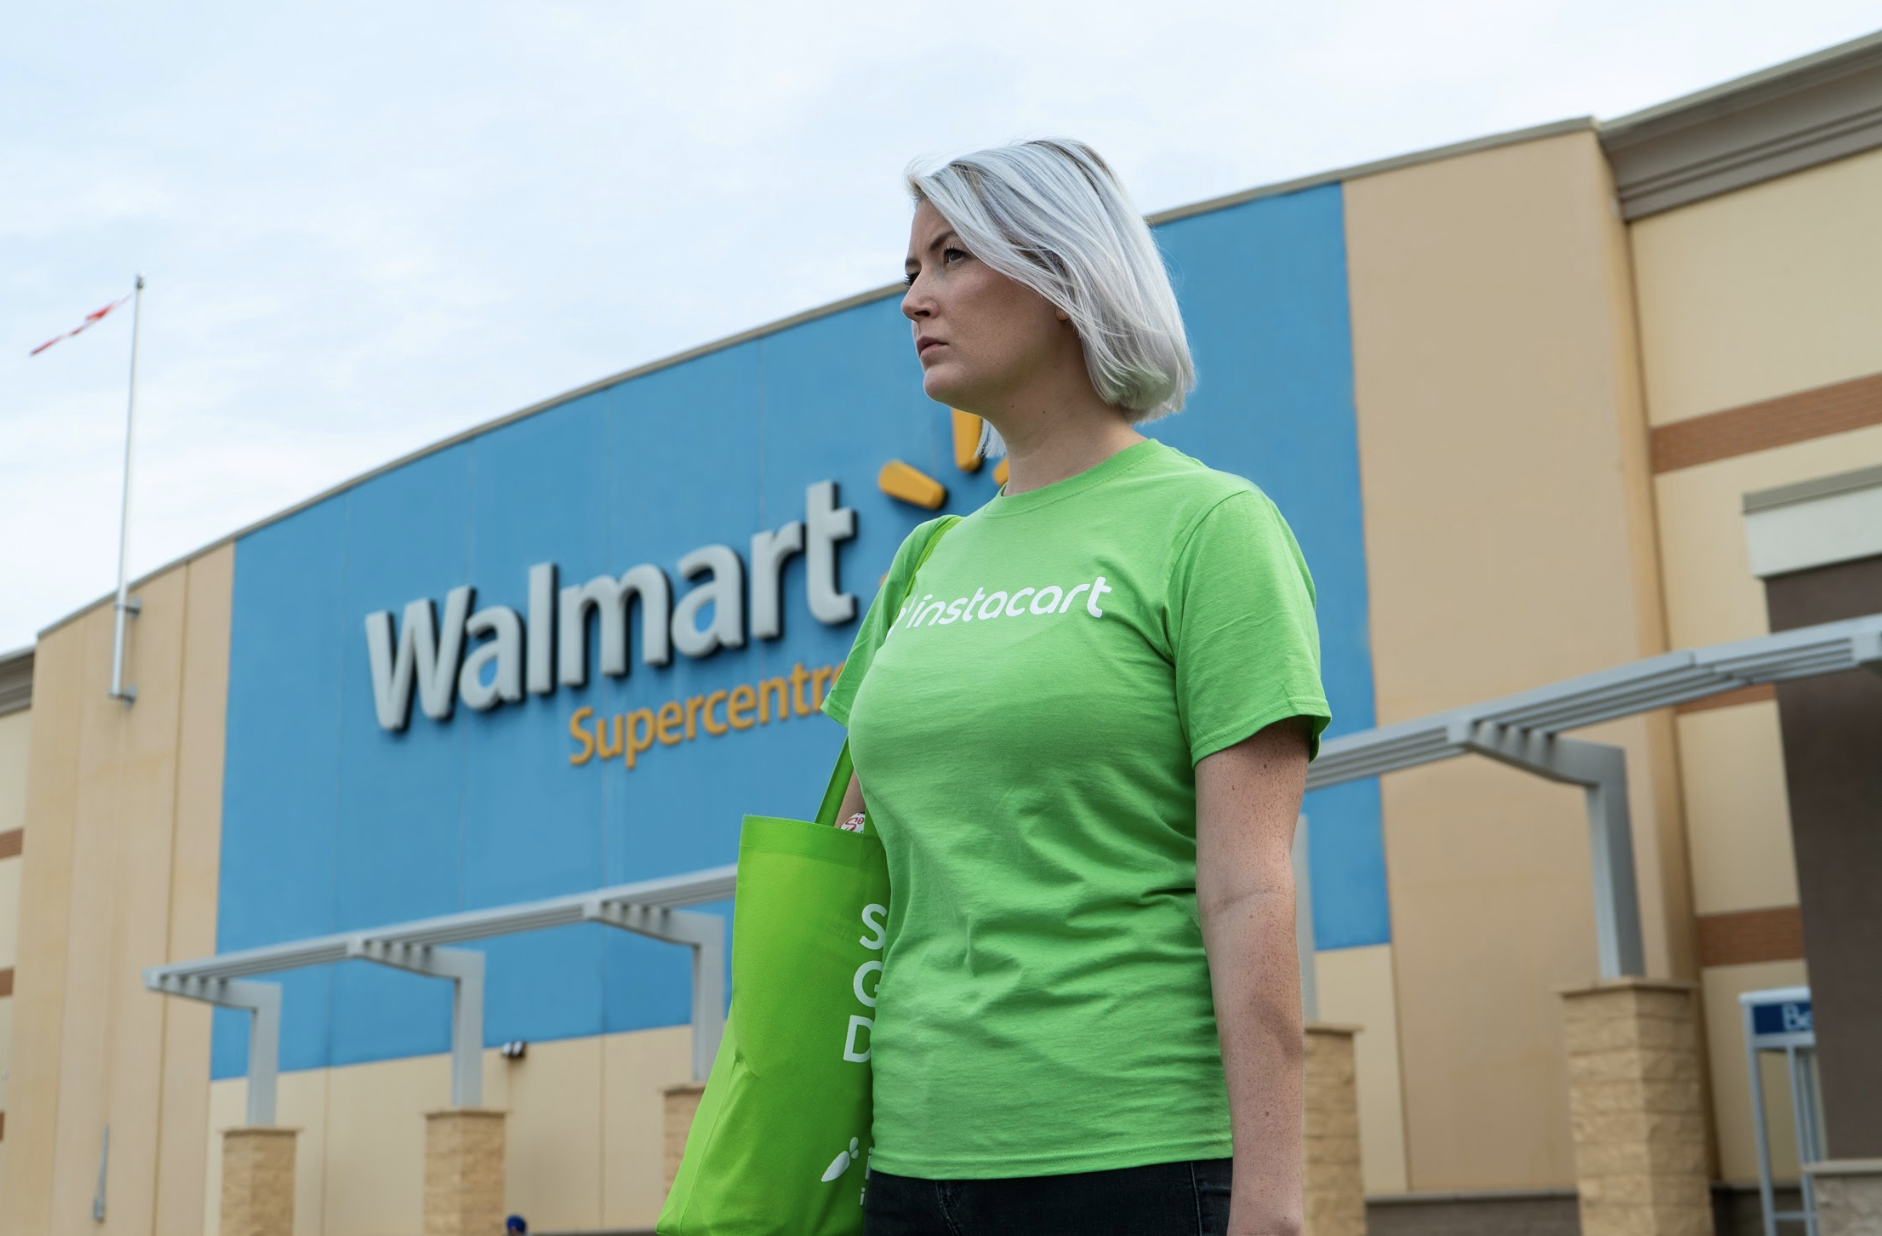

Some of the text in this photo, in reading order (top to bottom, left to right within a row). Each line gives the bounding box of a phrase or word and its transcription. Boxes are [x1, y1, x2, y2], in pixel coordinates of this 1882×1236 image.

[365, 480, 856, 731] Walmart
[905, 576, 1112, 629] instacart
[569, 661, 846, 768] Supercentr
